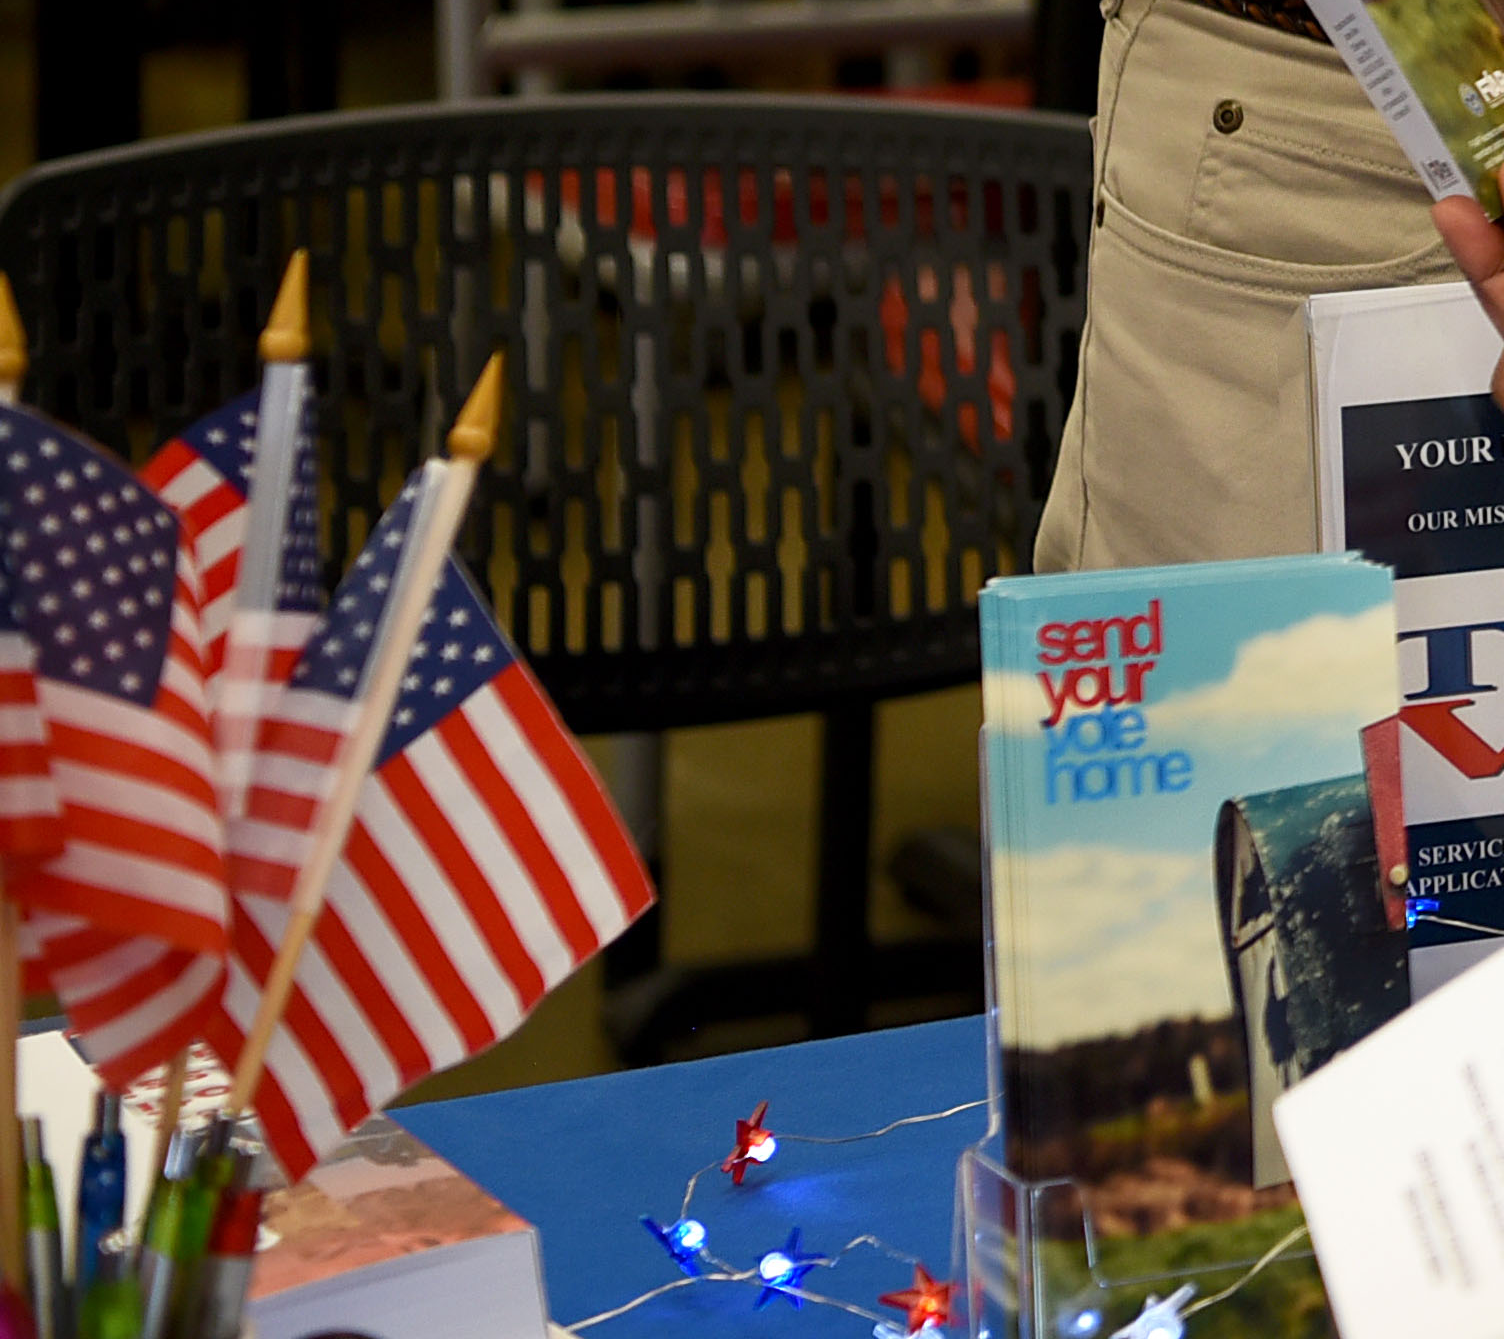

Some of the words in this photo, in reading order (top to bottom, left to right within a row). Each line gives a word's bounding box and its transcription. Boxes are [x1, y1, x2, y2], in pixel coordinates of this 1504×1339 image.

[1396, 436, 1495, 470] YOUR
[1408, 510, 1459, 532] OUR
[1036, 599, 1163, 666] send
[1036, 660, 1156, 728] your
[1045, 703, 1148, 757] vote
[1045, 747, 1193, 806] home
